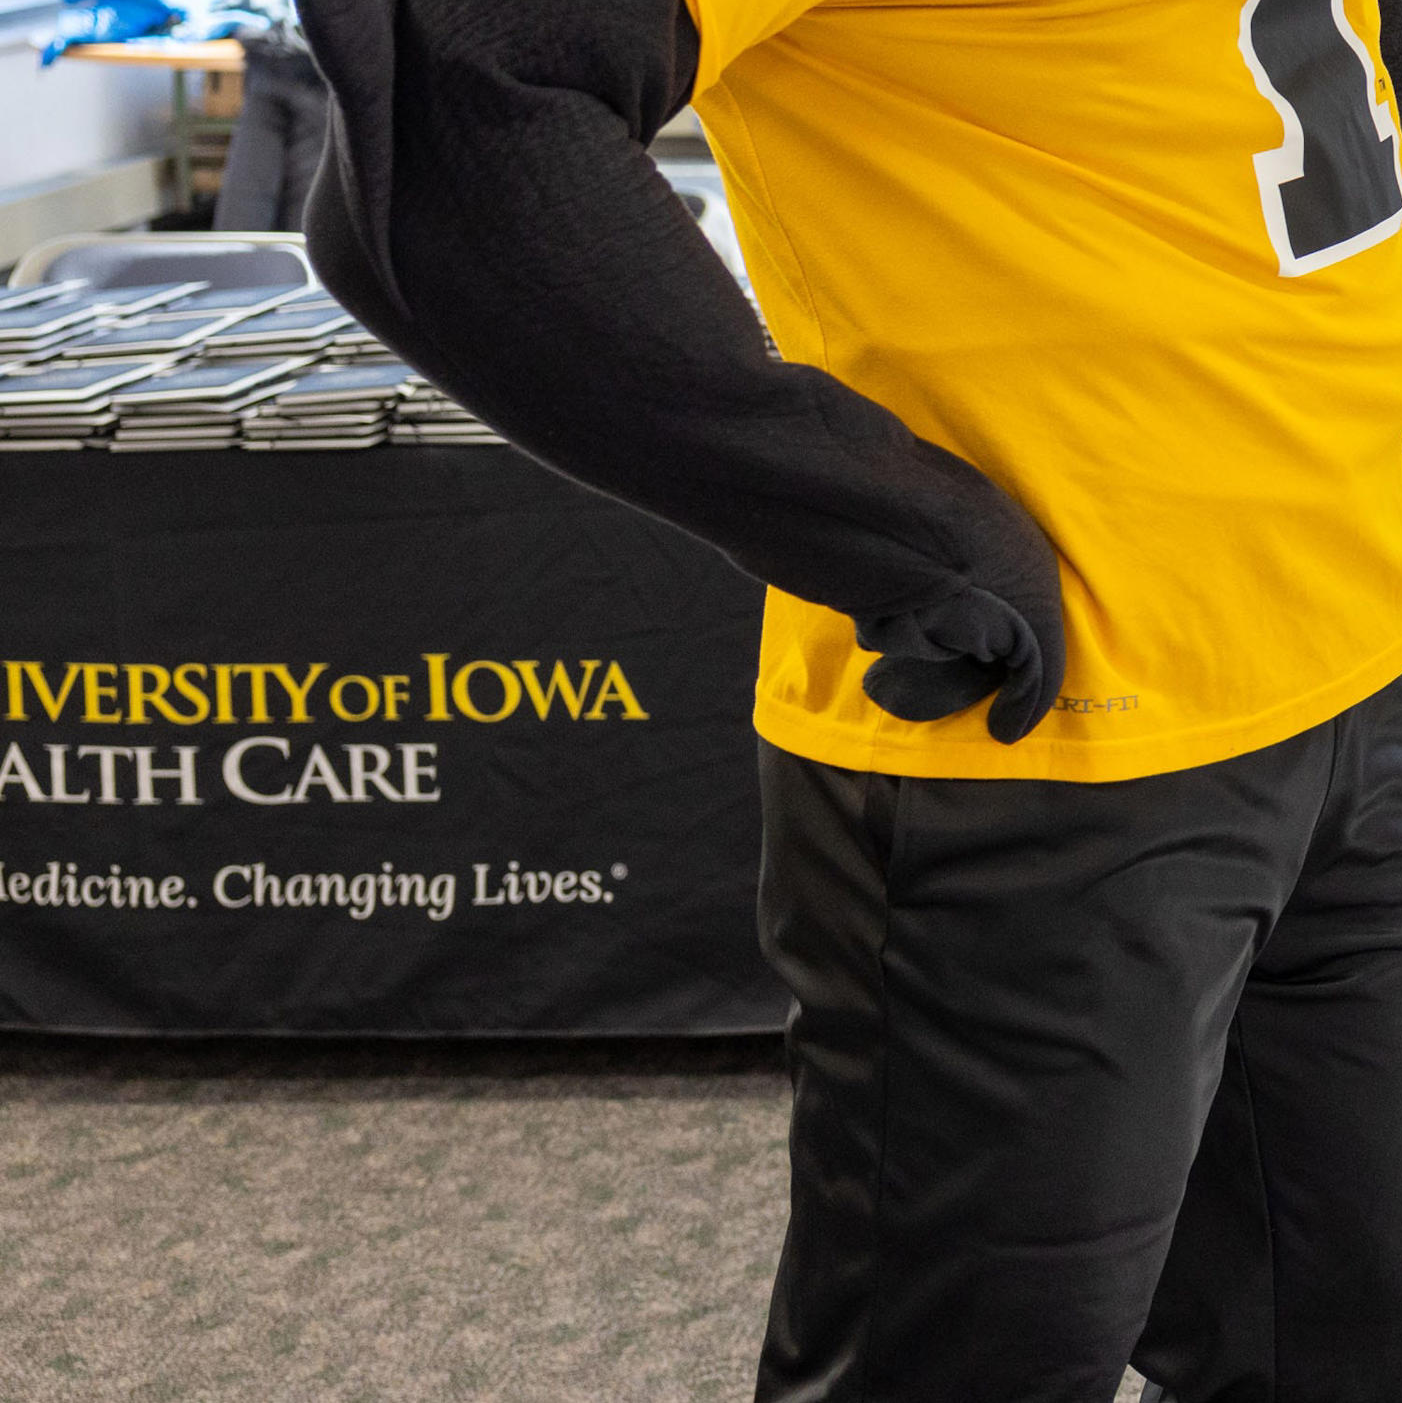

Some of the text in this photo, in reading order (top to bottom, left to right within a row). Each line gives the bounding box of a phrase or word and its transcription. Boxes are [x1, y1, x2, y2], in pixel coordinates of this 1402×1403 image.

[5, 660, 327, 725] IVERSITY
[423, 653, 649, 723] IOWA
[0, 736, 441, 805] ALTH CARE
[213, 862, 456, 921] Changing
